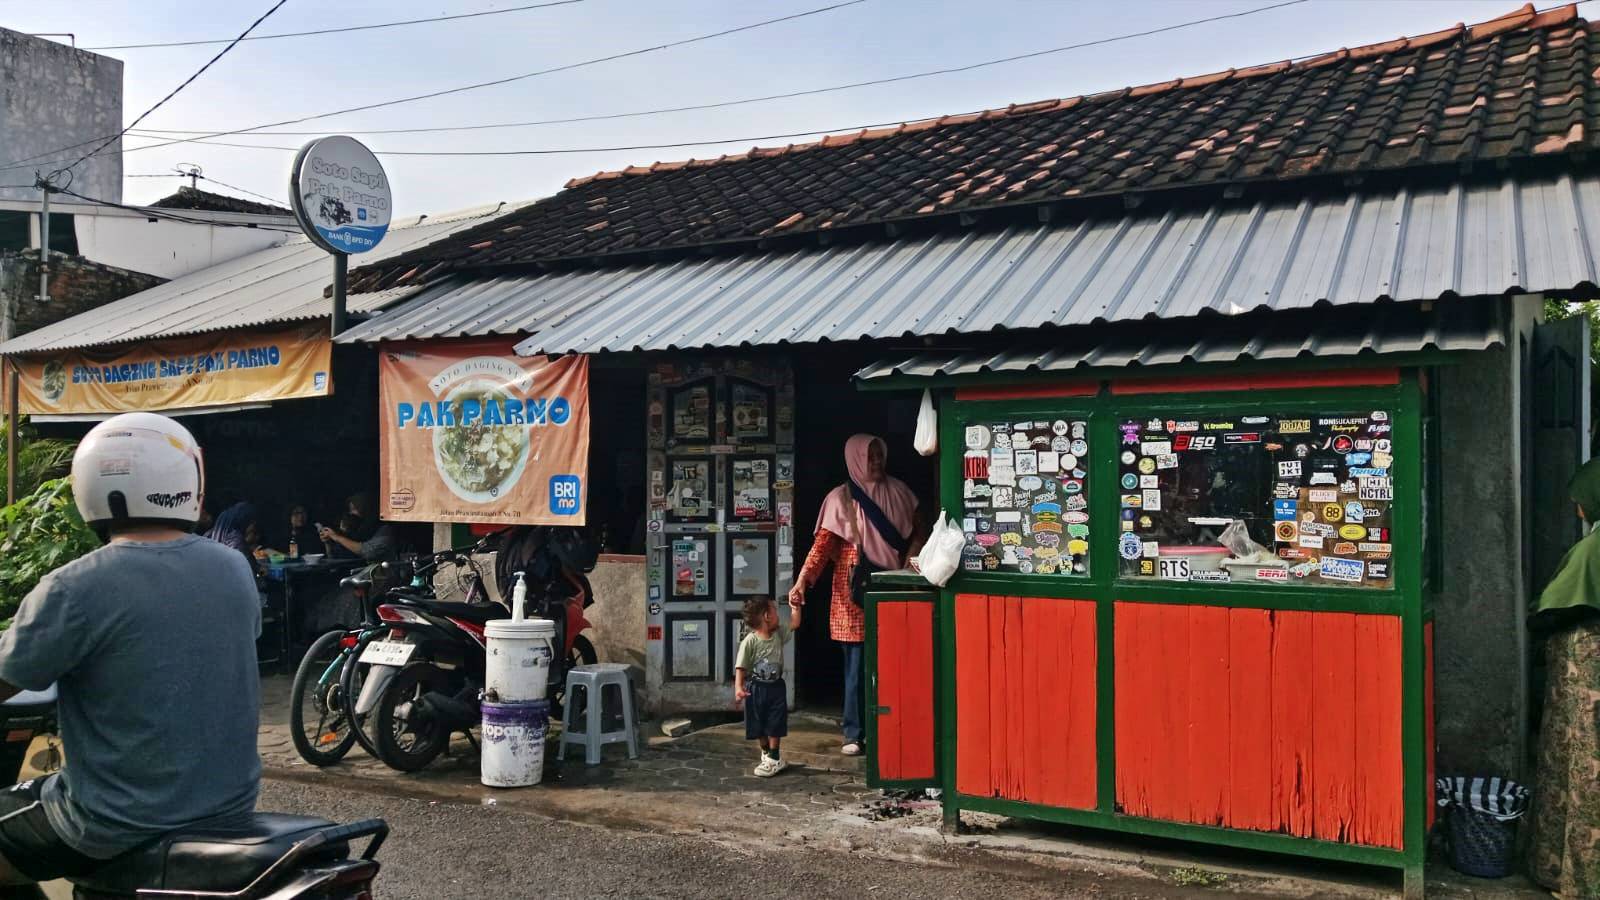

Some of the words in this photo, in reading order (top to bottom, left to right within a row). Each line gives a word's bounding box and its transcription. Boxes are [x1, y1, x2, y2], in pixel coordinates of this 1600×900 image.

[312, 157, 349, 180] Soto
[351, 167, 385, 190] Sapi
[308, 178, 340, 198] Pak
[343, 186, 388, 210] Parno
[227, 345, 281, 369] PARNO
[397, 400, 455, 428] PAK
[462, 396, 571, 428] PARNO
[554, 481, 576, 498] BRI
[1361, 489, 1392, 499] NCTRL
[559, 498, 576, 508] mo
[1326, 506, 1340, 518] 88
[1160, 560, 1188, 577] RTS
